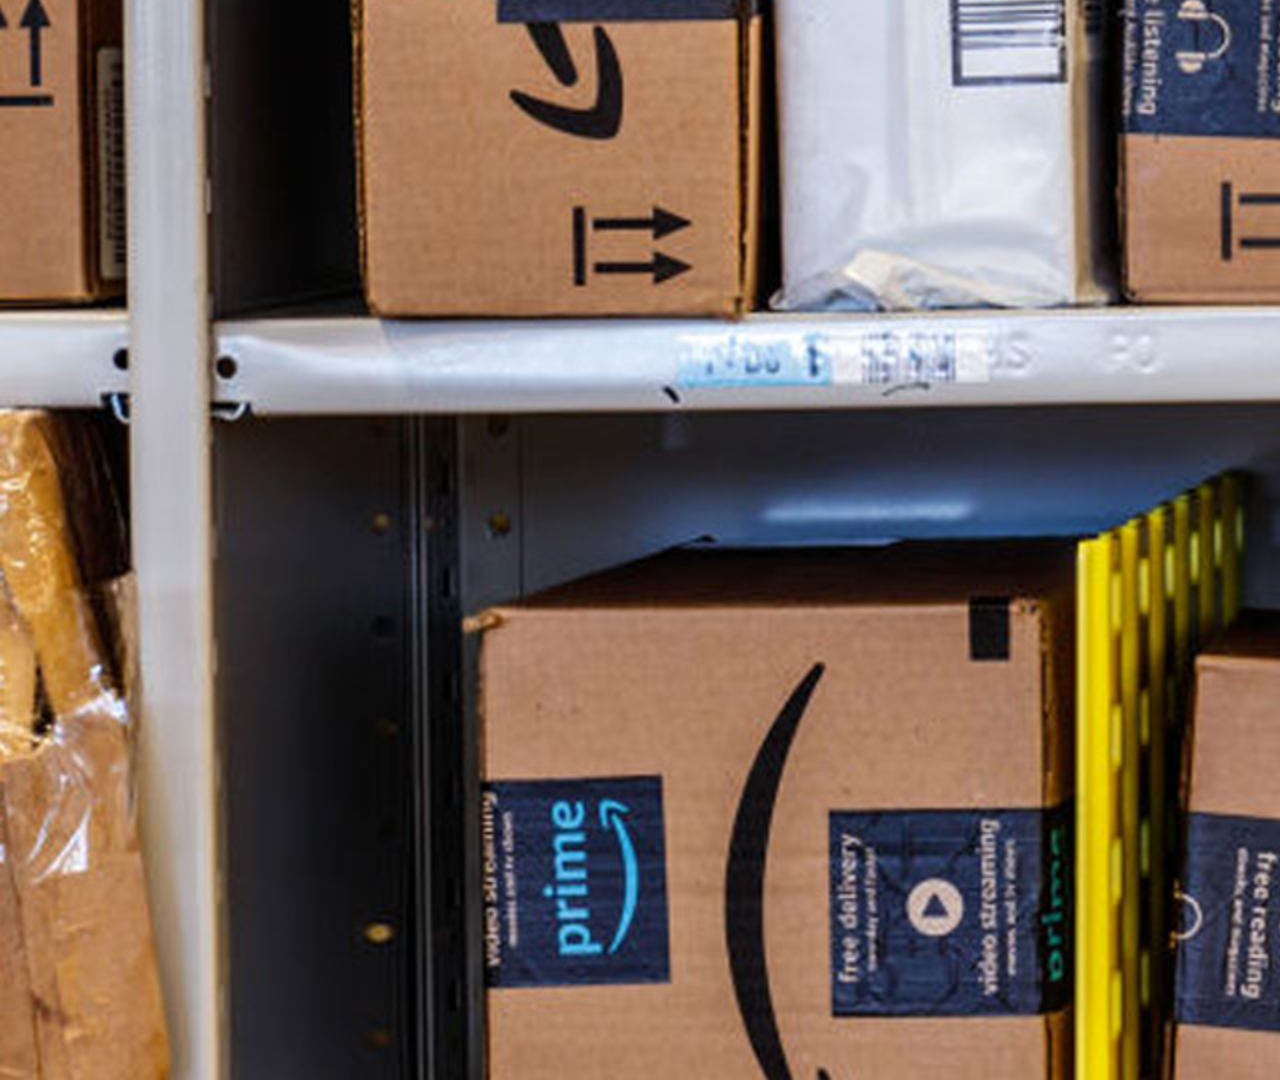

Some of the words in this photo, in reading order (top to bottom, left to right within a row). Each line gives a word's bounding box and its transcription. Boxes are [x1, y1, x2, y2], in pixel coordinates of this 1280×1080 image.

[1139, 11, 1164, 115] listening
[543, 800, 603, 954] prime
[838, 834, 864, 929] delivery
[976, 819, 1001, 930] streaming
[1253, 852, 1278, 899] free
[838, 937, 859, 983] free
[977, 934, 999, 995] video
[1240, 907, 1268, 999] reading
